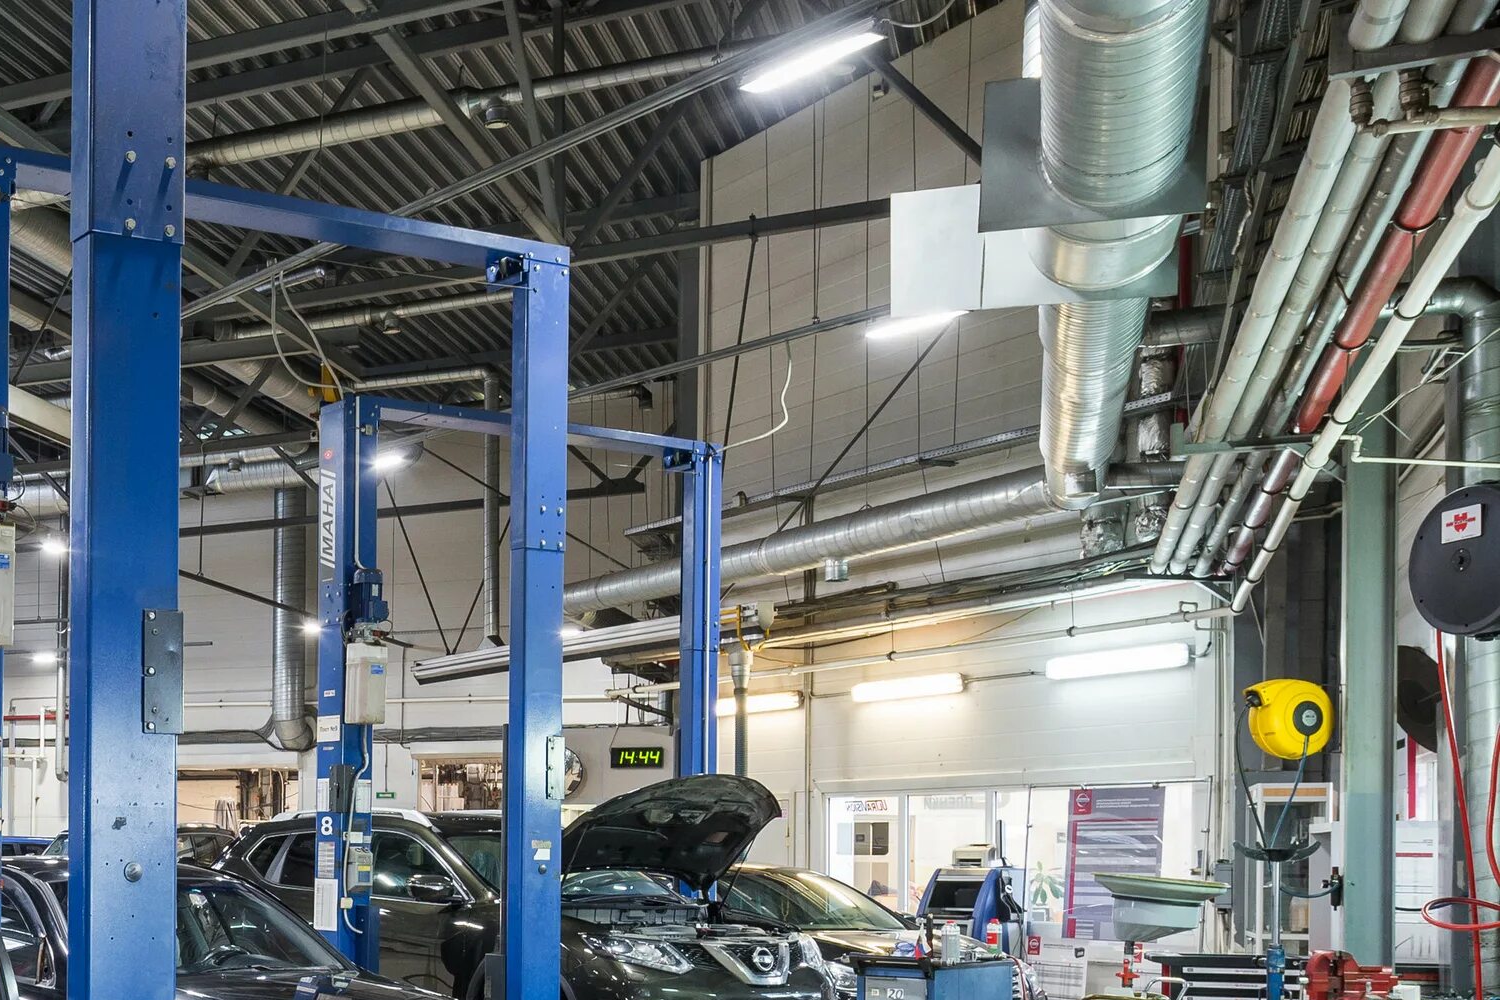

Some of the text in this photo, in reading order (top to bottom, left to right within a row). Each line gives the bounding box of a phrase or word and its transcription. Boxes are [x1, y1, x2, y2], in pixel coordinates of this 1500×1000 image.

[322, 483, 334, 557] MAHA
[619, 751, 660, 764] 14:44
[321, 816, 333, 835] 8
[889, 989, 903, 1000] 20
